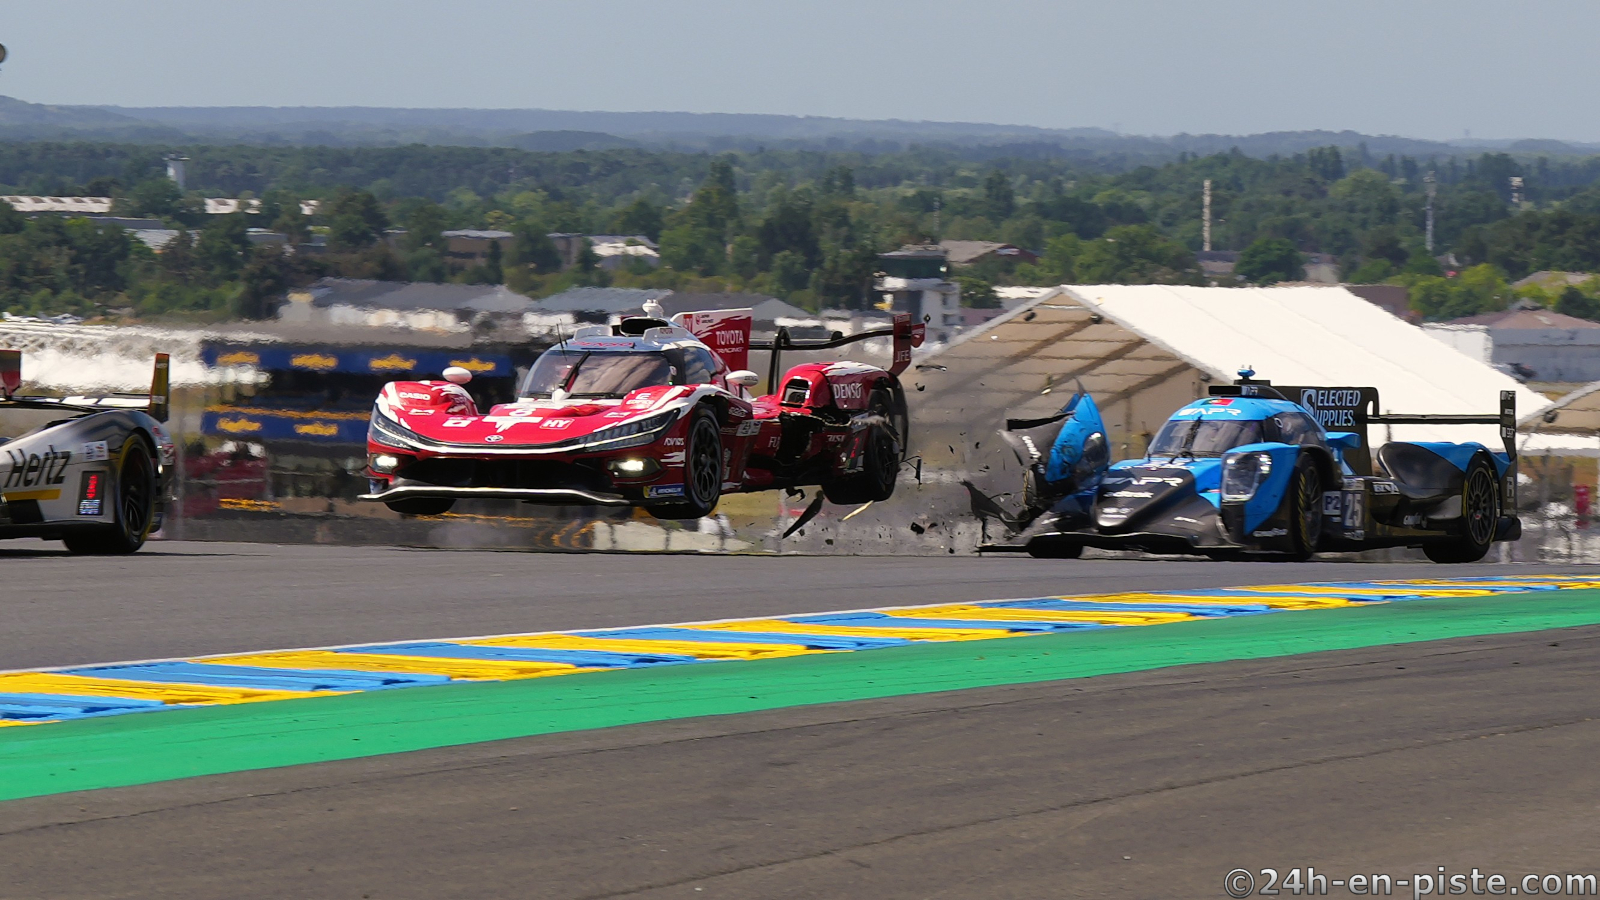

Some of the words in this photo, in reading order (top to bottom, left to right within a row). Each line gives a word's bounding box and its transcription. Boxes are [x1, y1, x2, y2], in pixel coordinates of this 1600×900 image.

[716, 330, 744, 345] TOYOTA
[895, 350, 909, 362] JFE
[399, 392, 431, 400] CASIO
[833, 383, 862, 399] DENSO
[542, 420, 570, 428] HY
[4, 444, 71, 488] Hertz
[1325, 496, 1340, 511] P2
[1344, 493, 1362, 527] 25
